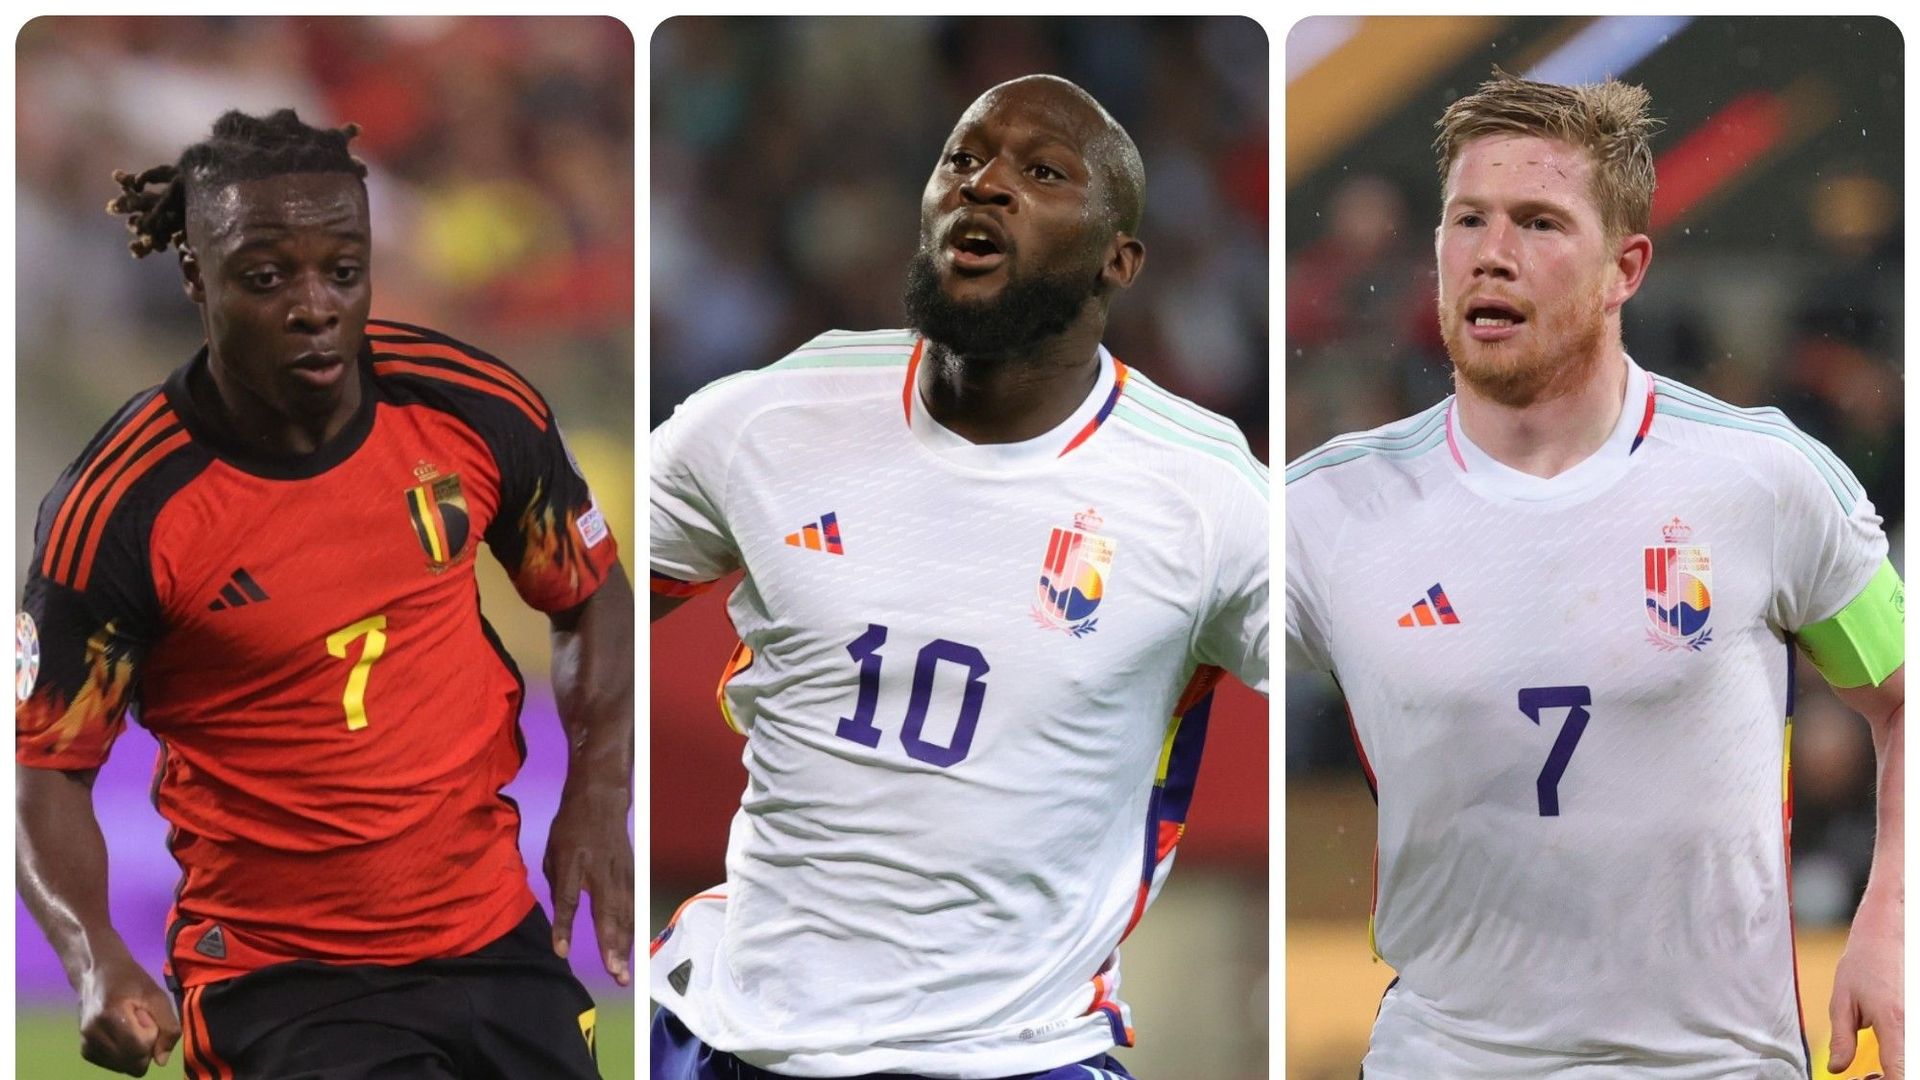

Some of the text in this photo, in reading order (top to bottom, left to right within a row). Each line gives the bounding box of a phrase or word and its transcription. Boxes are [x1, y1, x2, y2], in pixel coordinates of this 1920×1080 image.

[326, 614, 387, 731] 7
[835, 623, 990, 768] 10
[1518, 685, 1592, 816] 7
